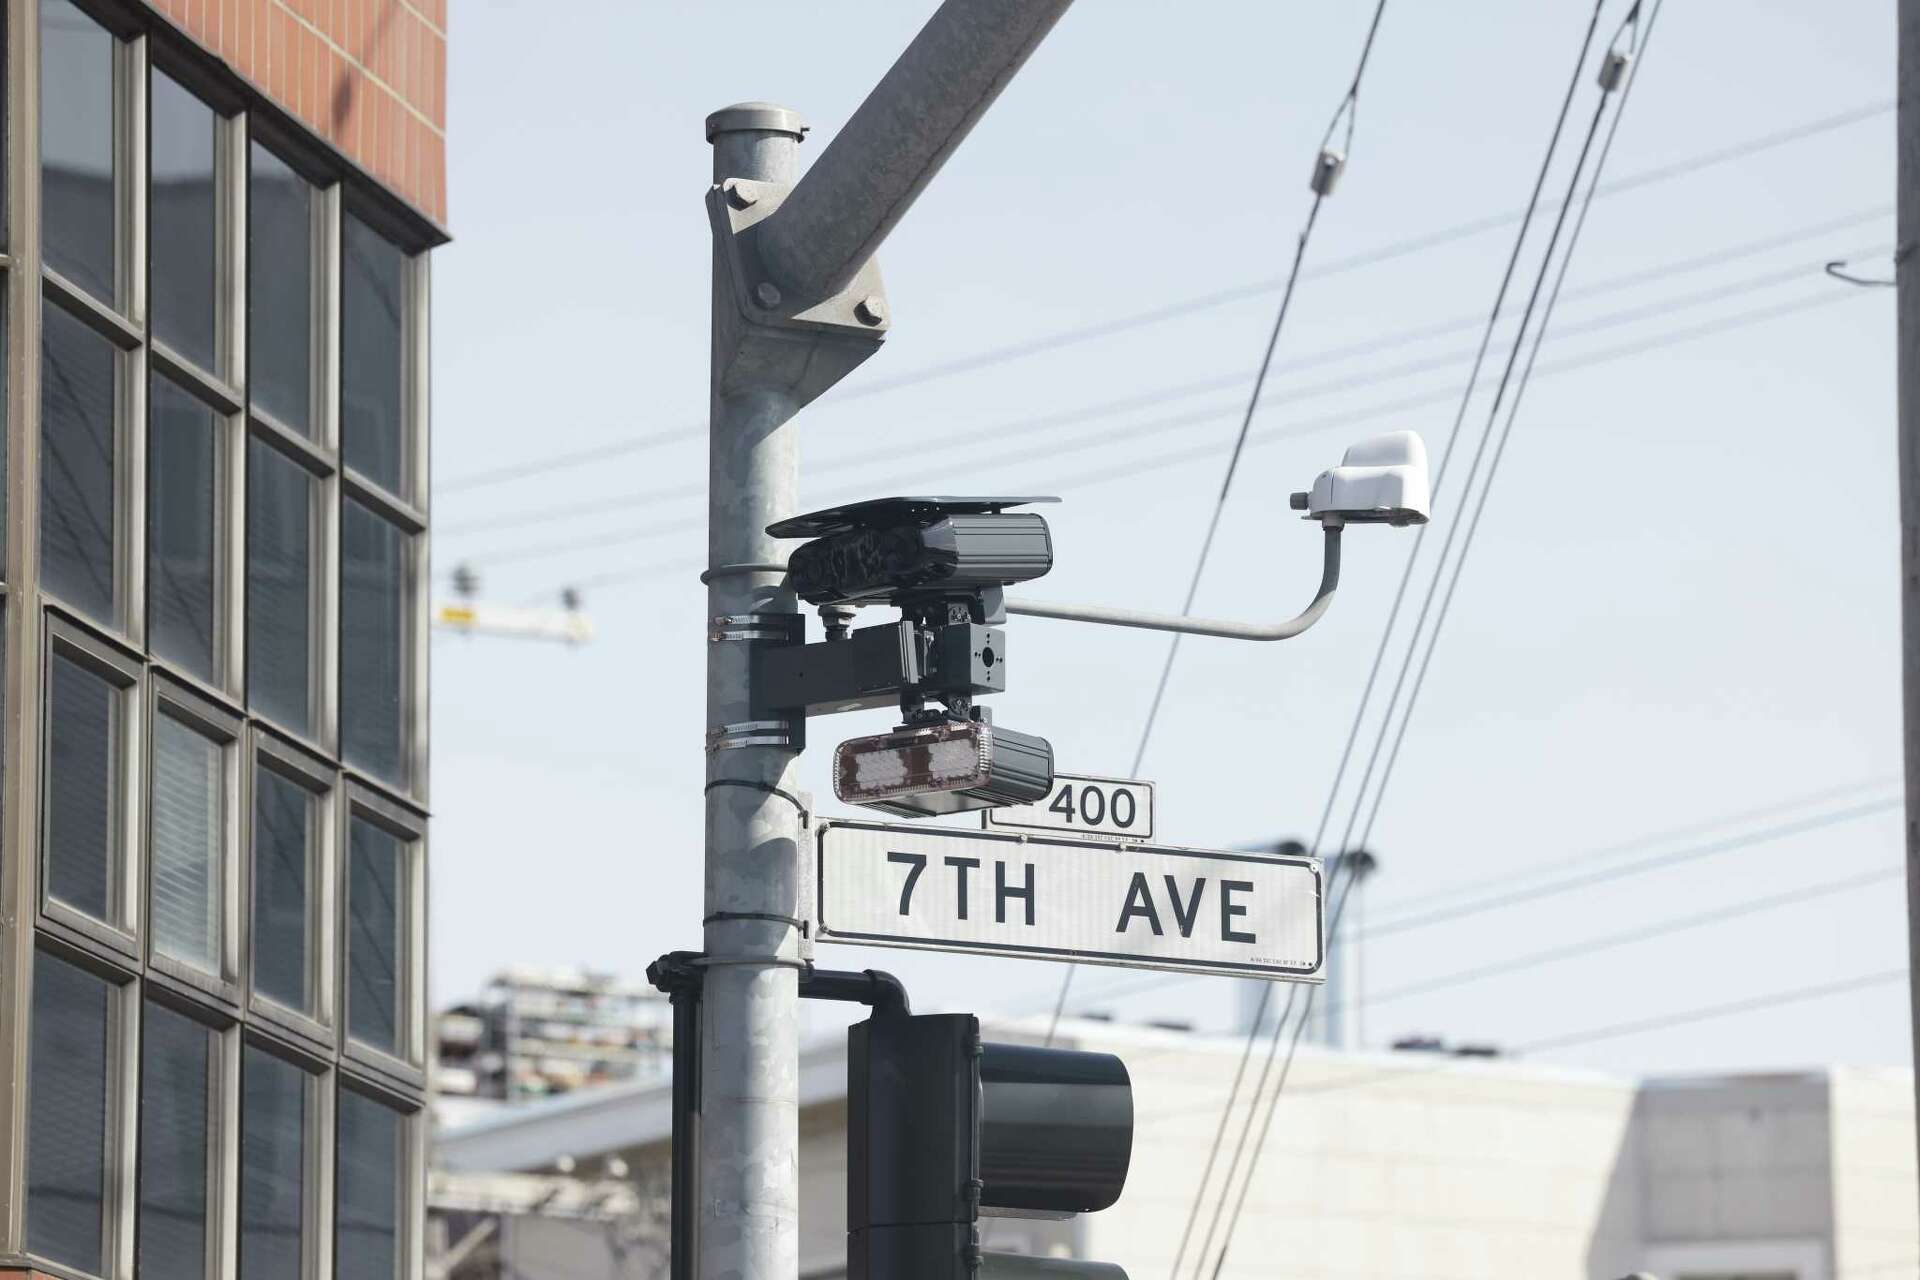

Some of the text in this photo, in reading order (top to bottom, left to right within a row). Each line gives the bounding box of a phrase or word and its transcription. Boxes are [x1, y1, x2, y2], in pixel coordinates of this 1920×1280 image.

[1048, 784, 1136, 829] 400
[887, 851, 1257, 944] 7TH AVE
